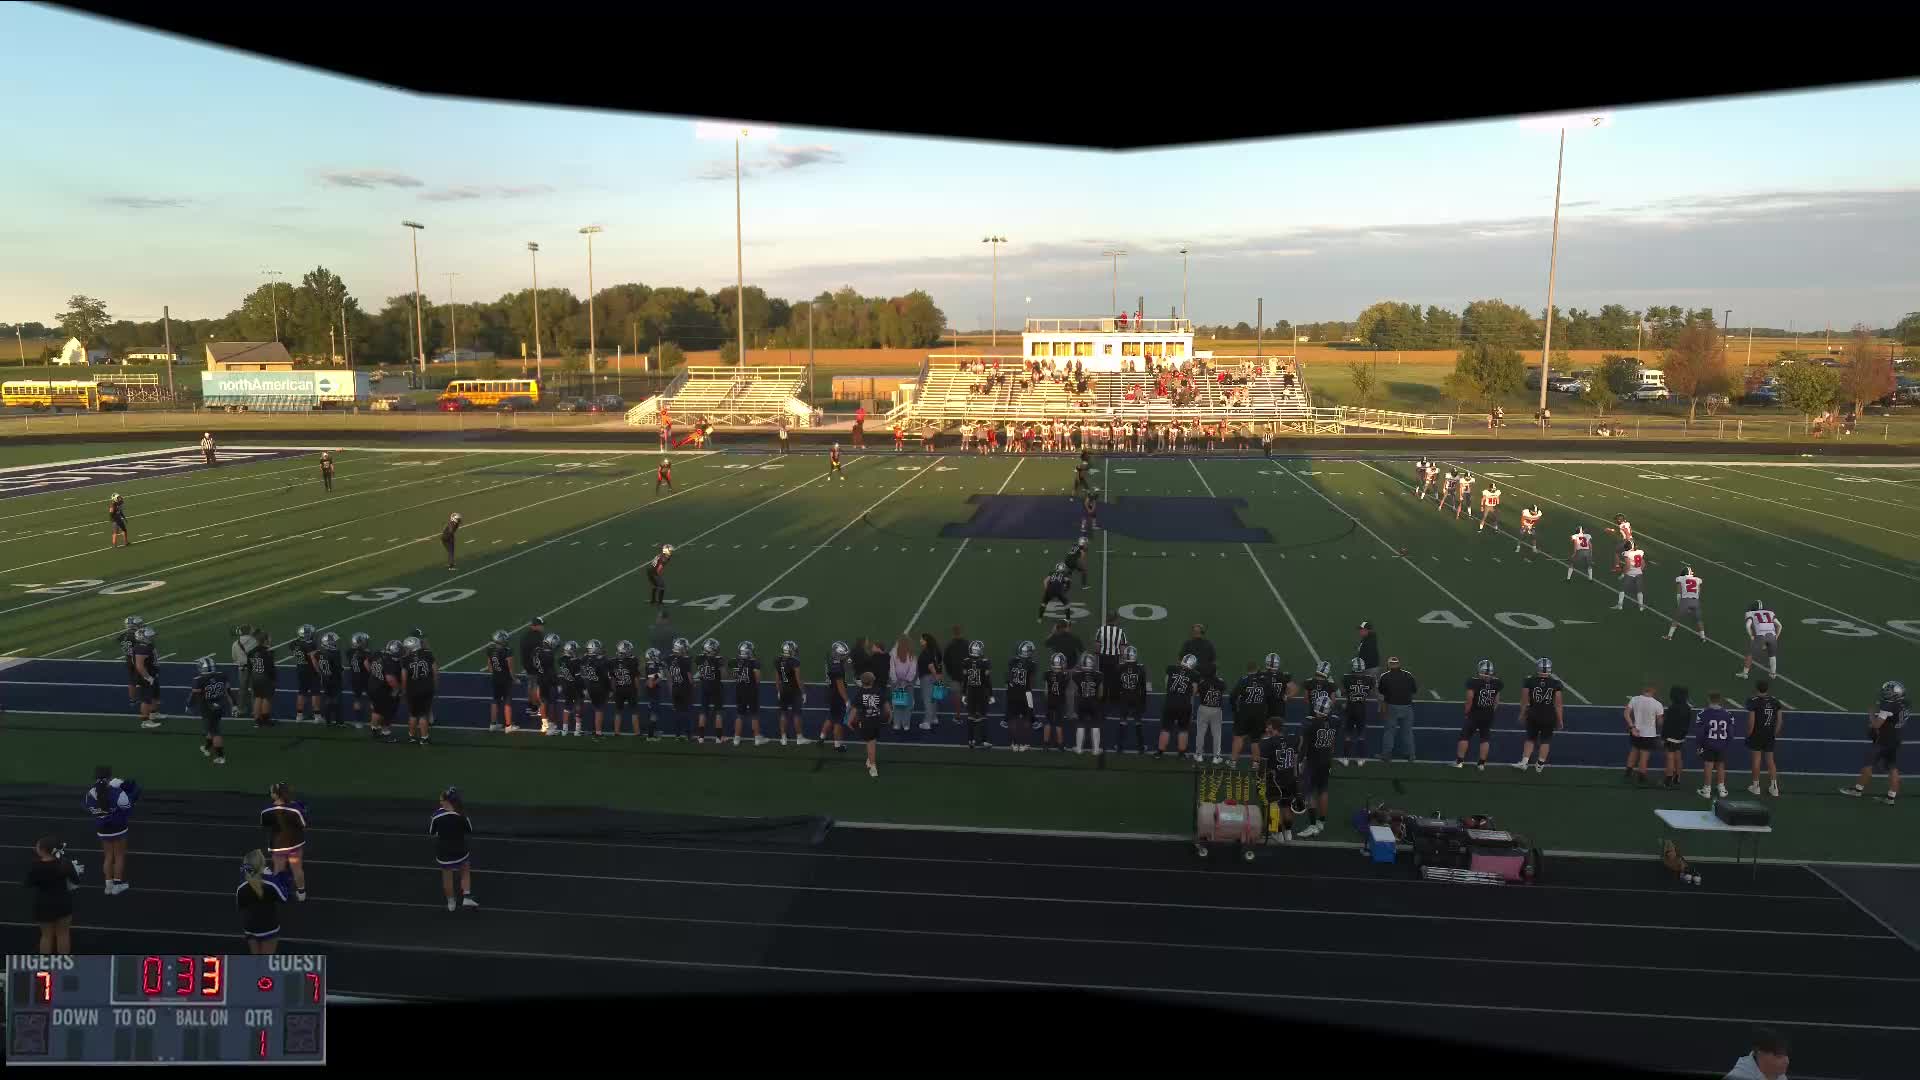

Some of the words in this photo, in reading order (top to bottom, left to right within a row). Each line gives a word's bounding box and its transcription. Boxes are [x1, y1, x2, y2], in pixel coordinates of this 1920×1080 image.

[219, 378, 314, 392] northAmerican
[1579, 537, 1588, 548] 3
[1685, 578, 1698, 593] 2
[346, 587, 478, 604] 30
[680, 594, 809, 612] 40
[1043, 602, 1168, 621] 50
[1417, 610, 1556, 630] 40
[1754, 612, 1774, 624] 11
[1533, 687, 1553, 704] 64
[1764, 708, 1774, 726] 7
[1708, 719, 1728, 740] 23
